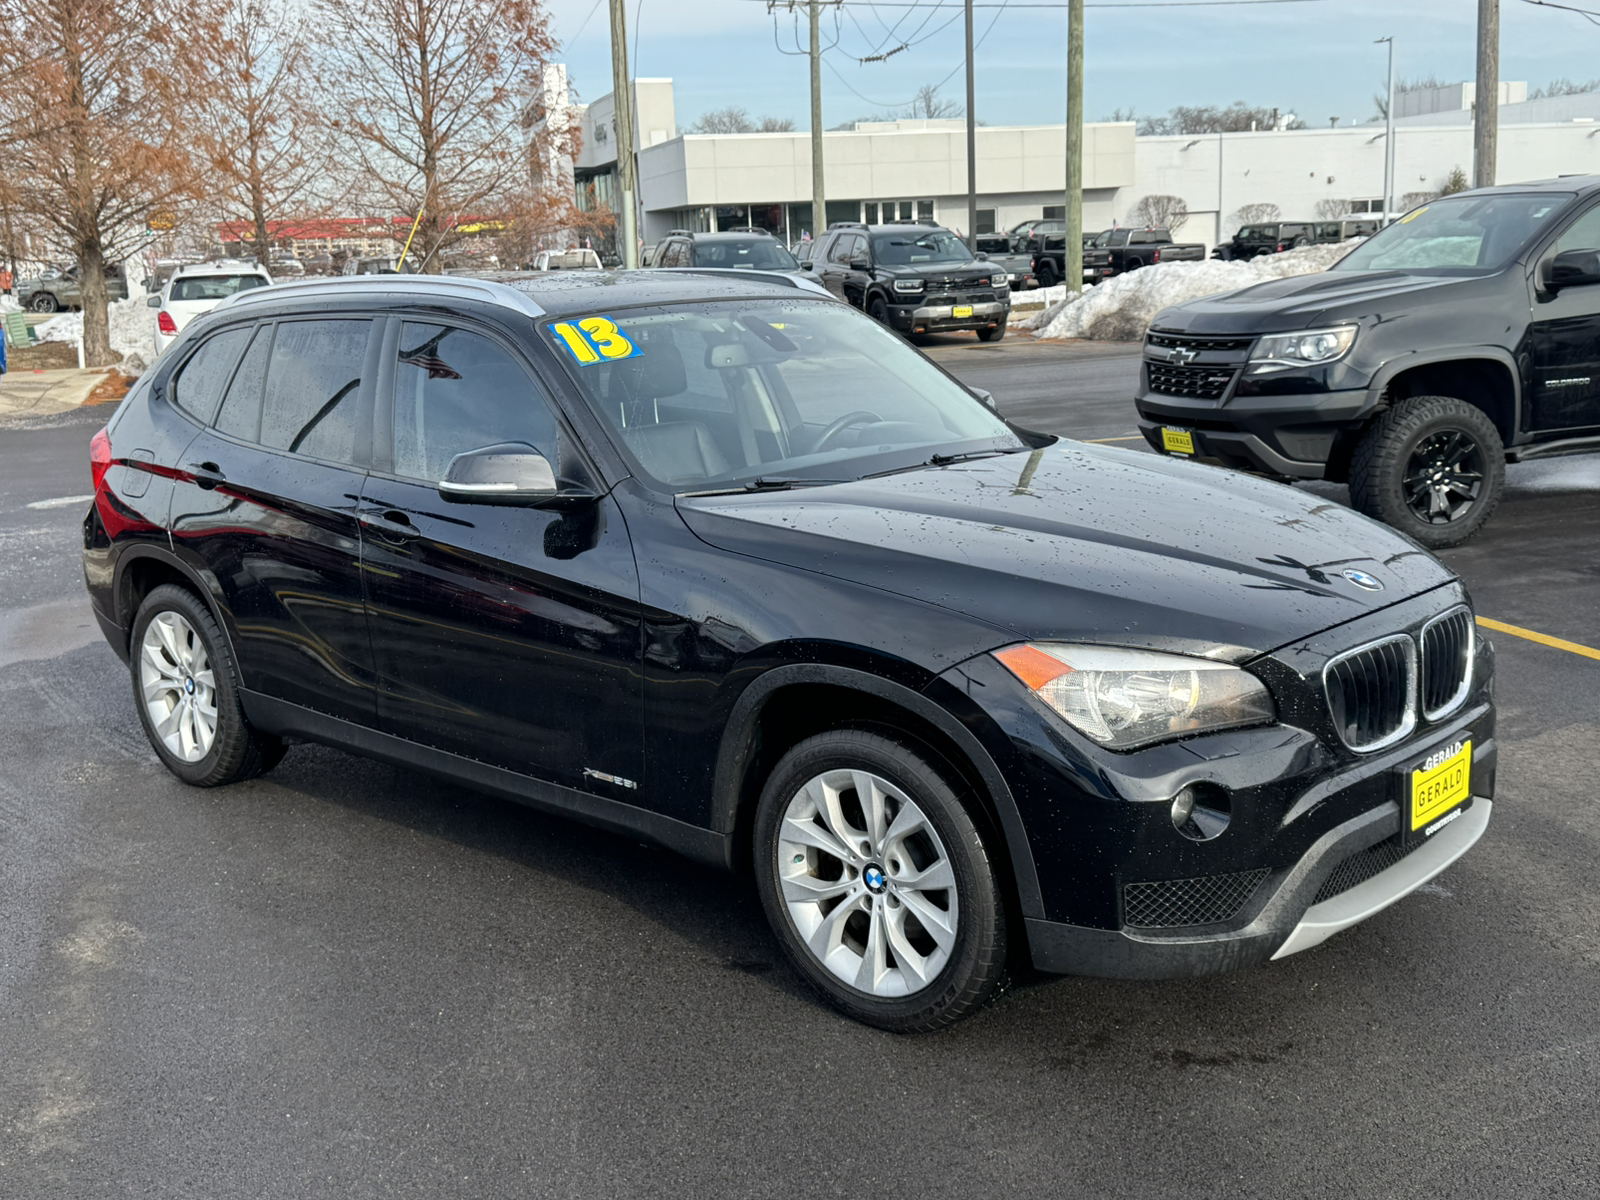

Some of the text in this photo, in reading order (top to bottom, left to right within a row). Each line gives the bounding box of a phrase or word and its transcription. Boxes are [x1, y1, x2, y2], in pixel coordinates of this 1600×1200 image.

[555, 317, 632, 363] 13
[1545, 377, 1591, 388] COLORADO
[1168, 435, 1190, 447] GERALD
[1425, 741, 1462, 771] GERALD
[1418, 768, 1462, 808] GERALD
